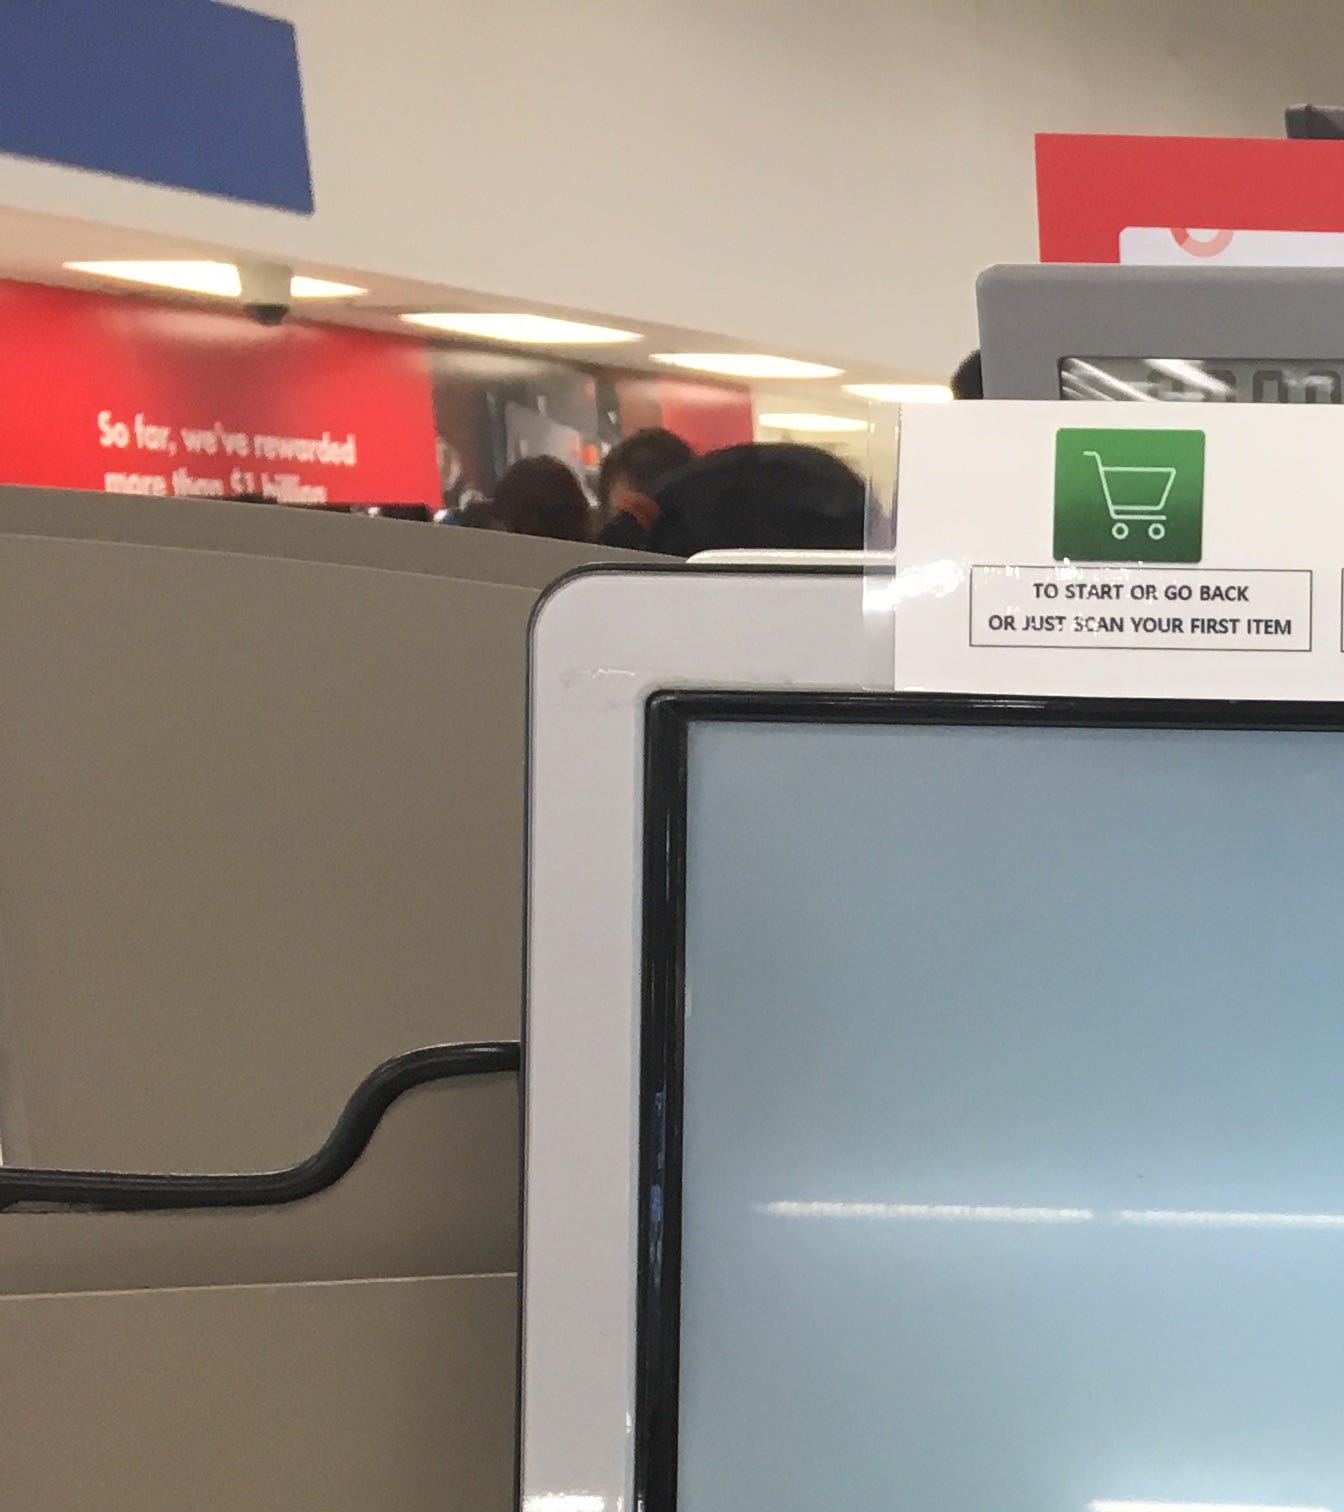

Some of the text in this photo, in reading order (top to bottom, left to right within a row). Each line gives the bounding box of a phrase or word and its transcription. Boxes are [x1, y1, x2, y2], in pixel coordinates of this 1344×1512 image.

[98, 410, 130, 448] So
[180, 421, 250, 458] we've
[254, 431, 357, 467] rewarded
[1033, 583, 1250, 602] TO START OR GO BACK
[988, 614, 1292, 636] OR JUST SCAN YOUR FIRST ITEM
